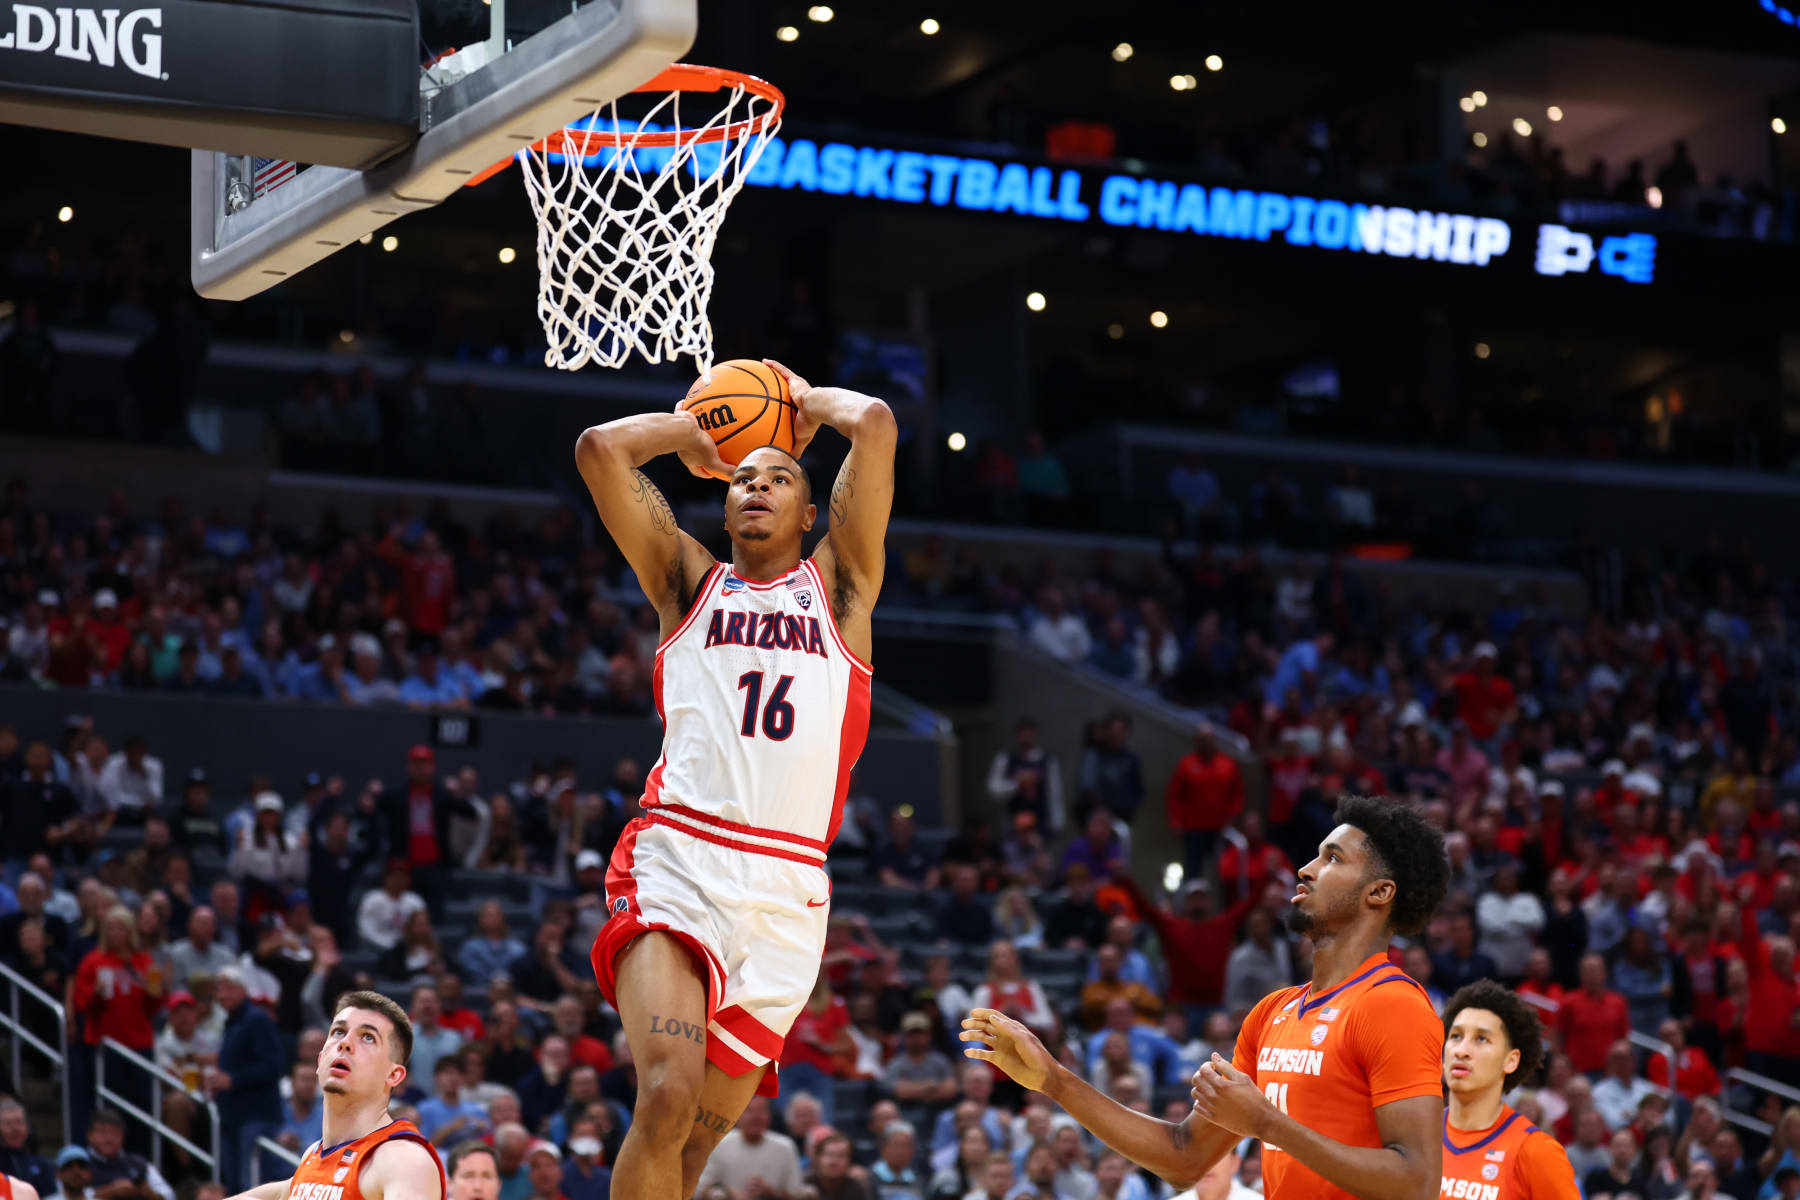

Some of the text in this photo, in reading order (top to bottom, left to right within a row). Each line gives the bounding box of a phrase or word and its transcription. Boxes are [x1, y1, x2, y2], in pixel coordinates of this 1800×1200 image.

[743, 134, 1090, 221] BASKETBALL
[1099, 175, 1511, 267] CHAMPIONSHIP
[704, 609, 828, 659] ARIZONA
[738, 670, 795, 742] 16
[650, 1016, 704, 1045] LOVE
[1257, 1047, 1324, 1077] CLEMSON
